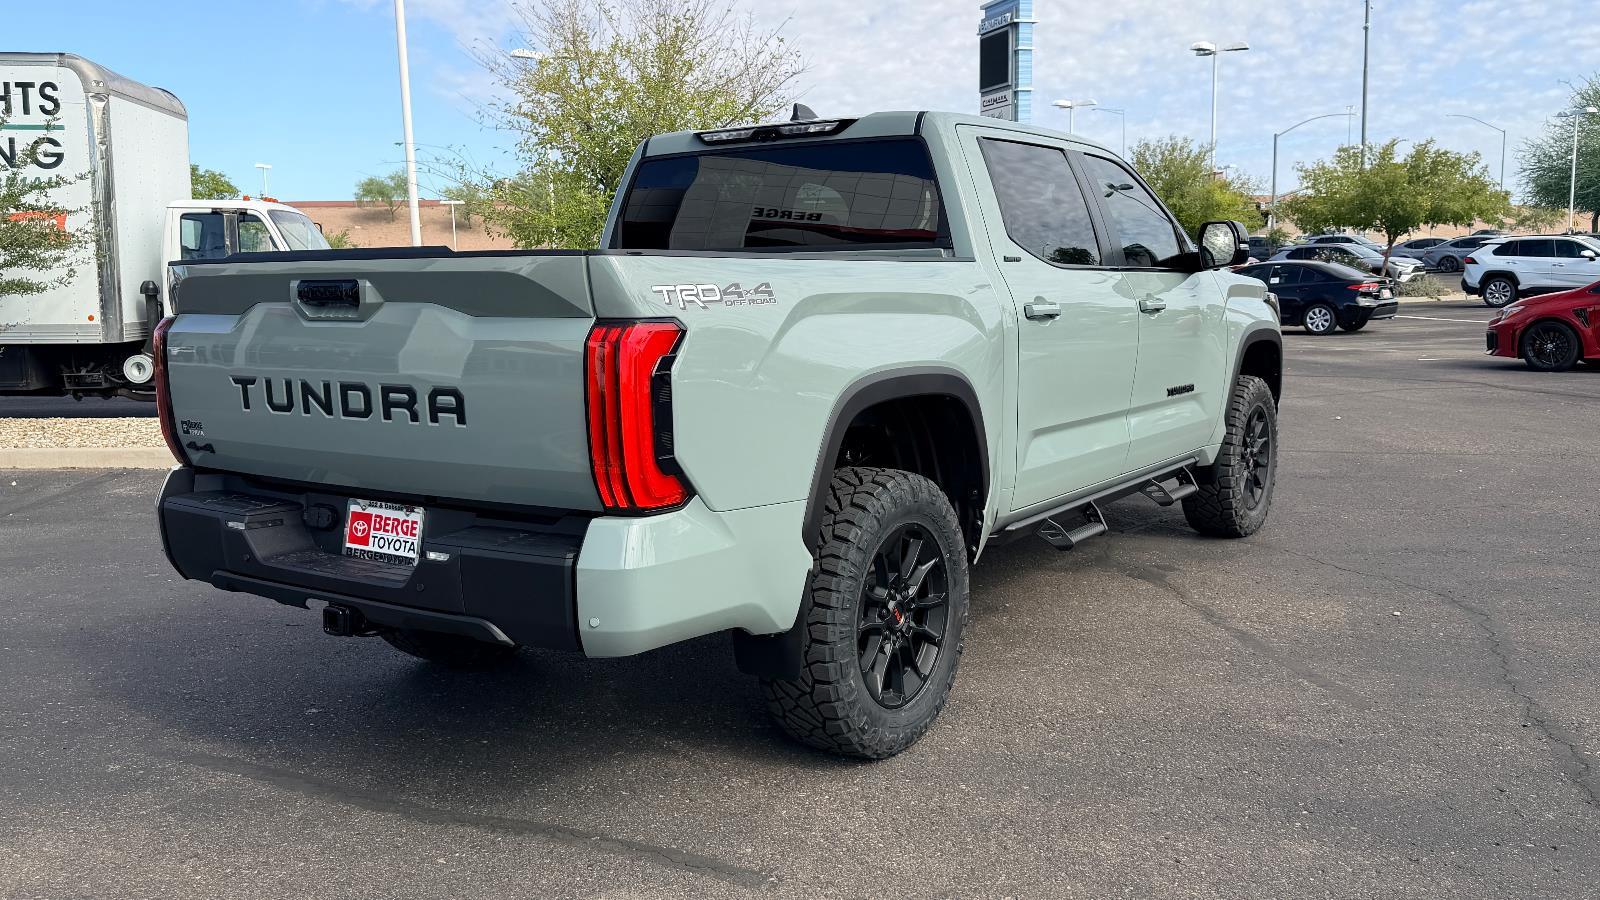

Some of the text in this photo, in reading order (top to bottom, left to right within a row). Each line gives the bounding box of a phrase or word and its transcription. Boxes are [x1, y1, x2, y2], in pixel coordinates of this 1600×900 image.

[651, 284, 723, 310] TRD
[725, 297, 777, 307] OFF ROAD
[229, 375, 467, 428] TUNDRA
[373, 514, 418, 537] BERGE
[346, 548, 379, 559] BERGE
[372, 535, 415, 554] TOYOTA
